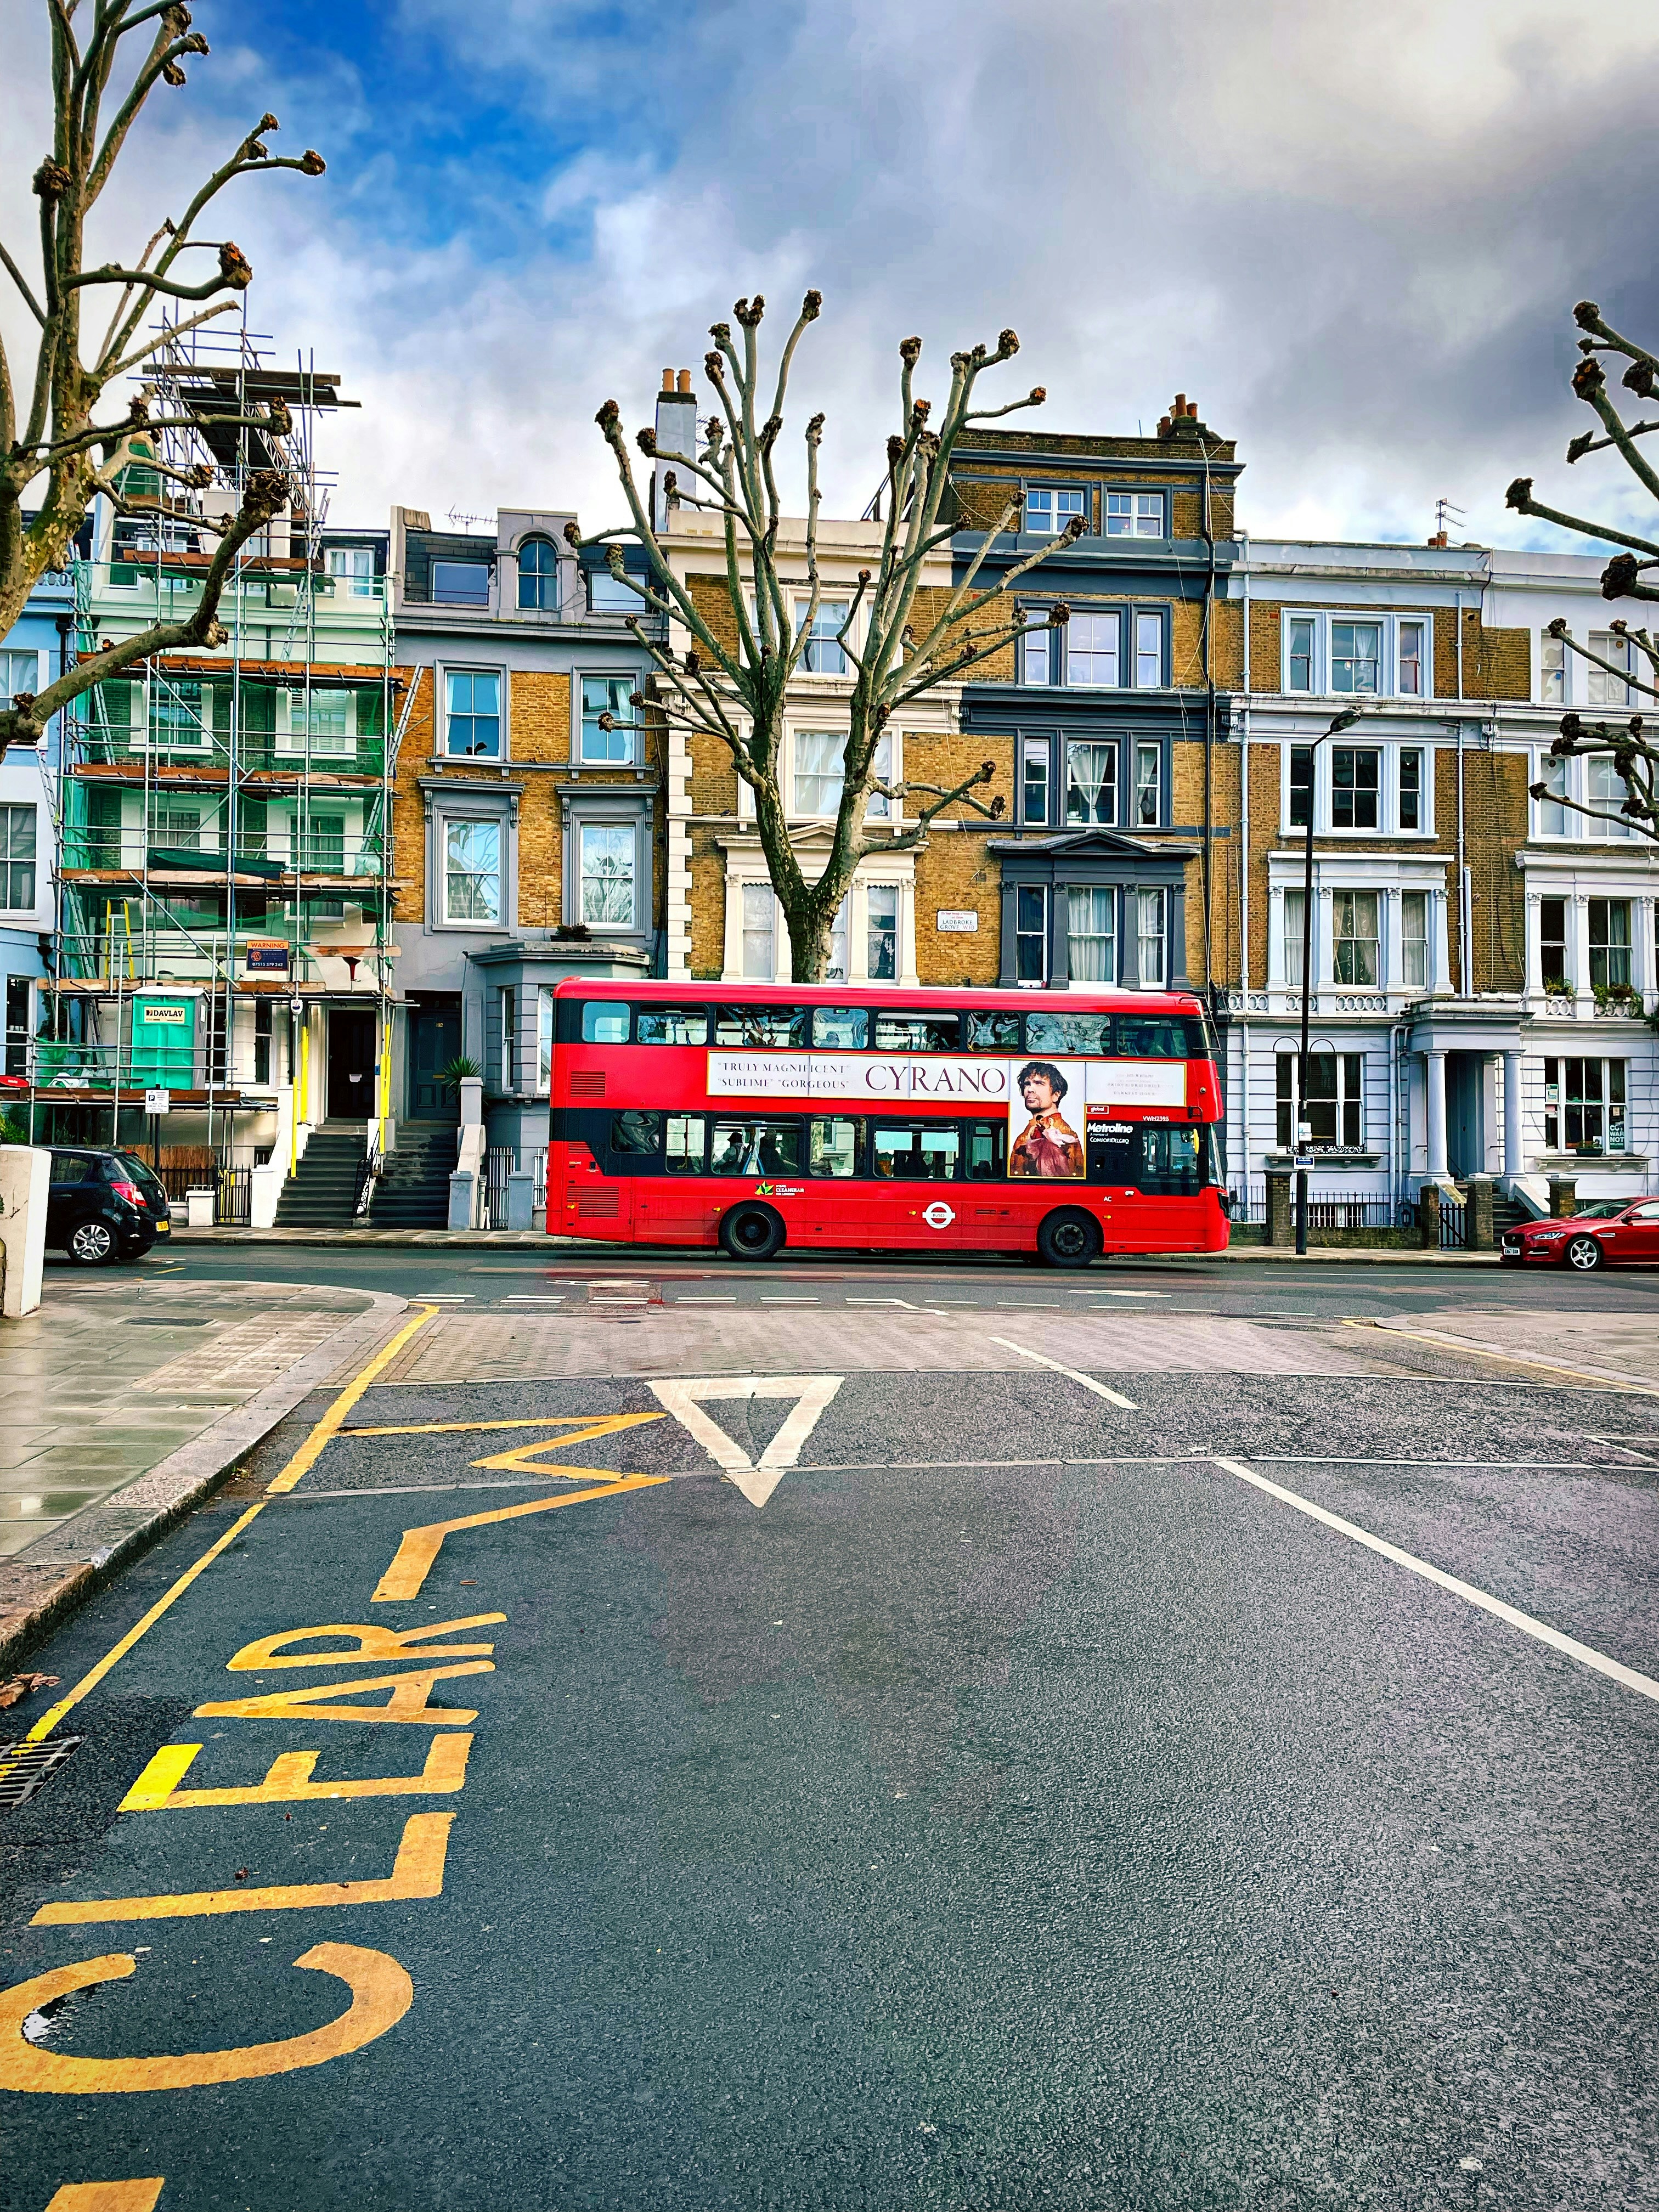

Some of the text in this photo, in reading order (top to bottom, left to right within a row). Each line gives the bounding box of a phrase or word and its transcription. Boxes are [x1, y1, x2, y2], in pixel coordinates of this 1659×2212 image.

[865, 1065, 1006, 1093] CYRANO
[1086, 1122, 1133, 1133] Metroline
[0, 1612, 507, 2095] CLEAR
